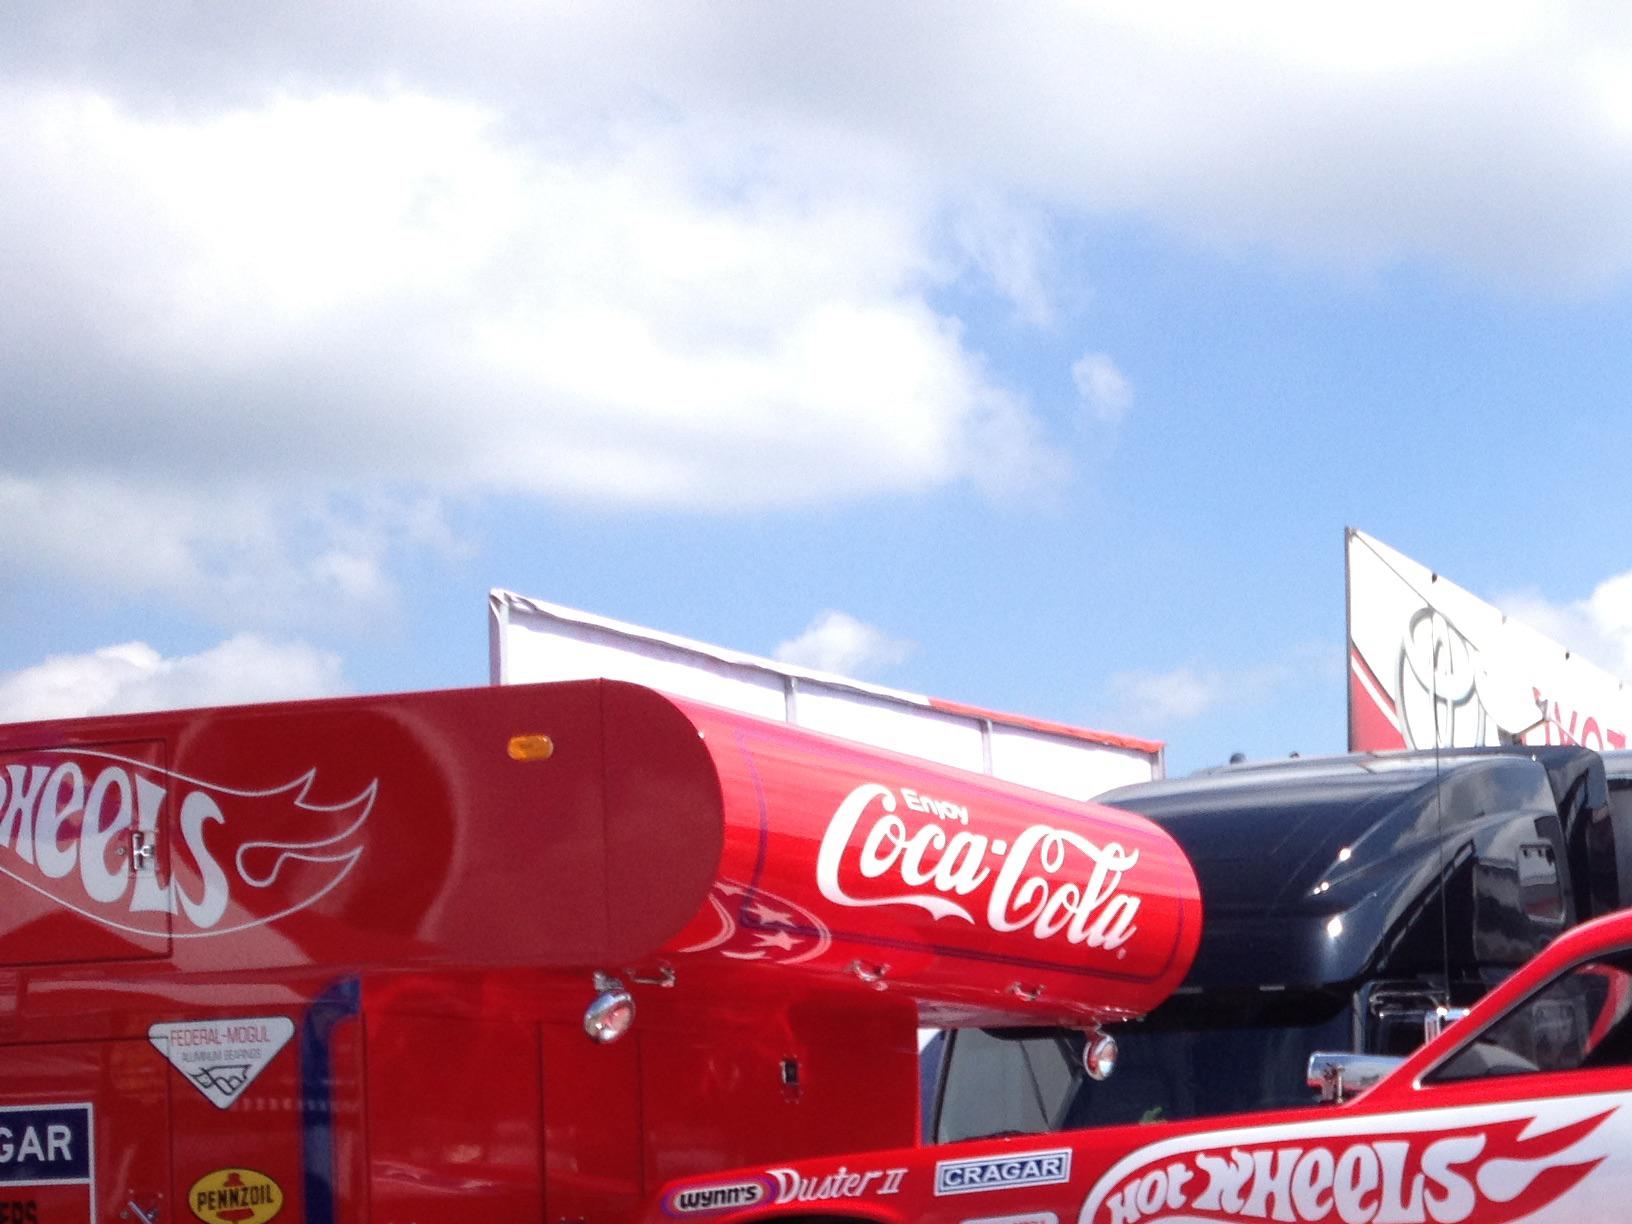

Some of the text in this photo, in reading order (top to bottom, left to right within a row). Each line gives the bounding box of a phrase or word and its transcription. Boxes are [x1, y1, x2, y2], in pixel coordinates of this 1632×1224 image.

[900, 787, 969, 825] Enjoy
[0, 762, 229, 928] HEELS
[816, 783, 1141, 951] Coca-Cola
[170, 1026, 271, 1047] FEDERAL-MOGUL
[766, 1167, 909, 1204] Duster II
[945, 1157, 1060, 1187] CRAGAR
[197, 1183, 275, 1213] PENNZOIL
